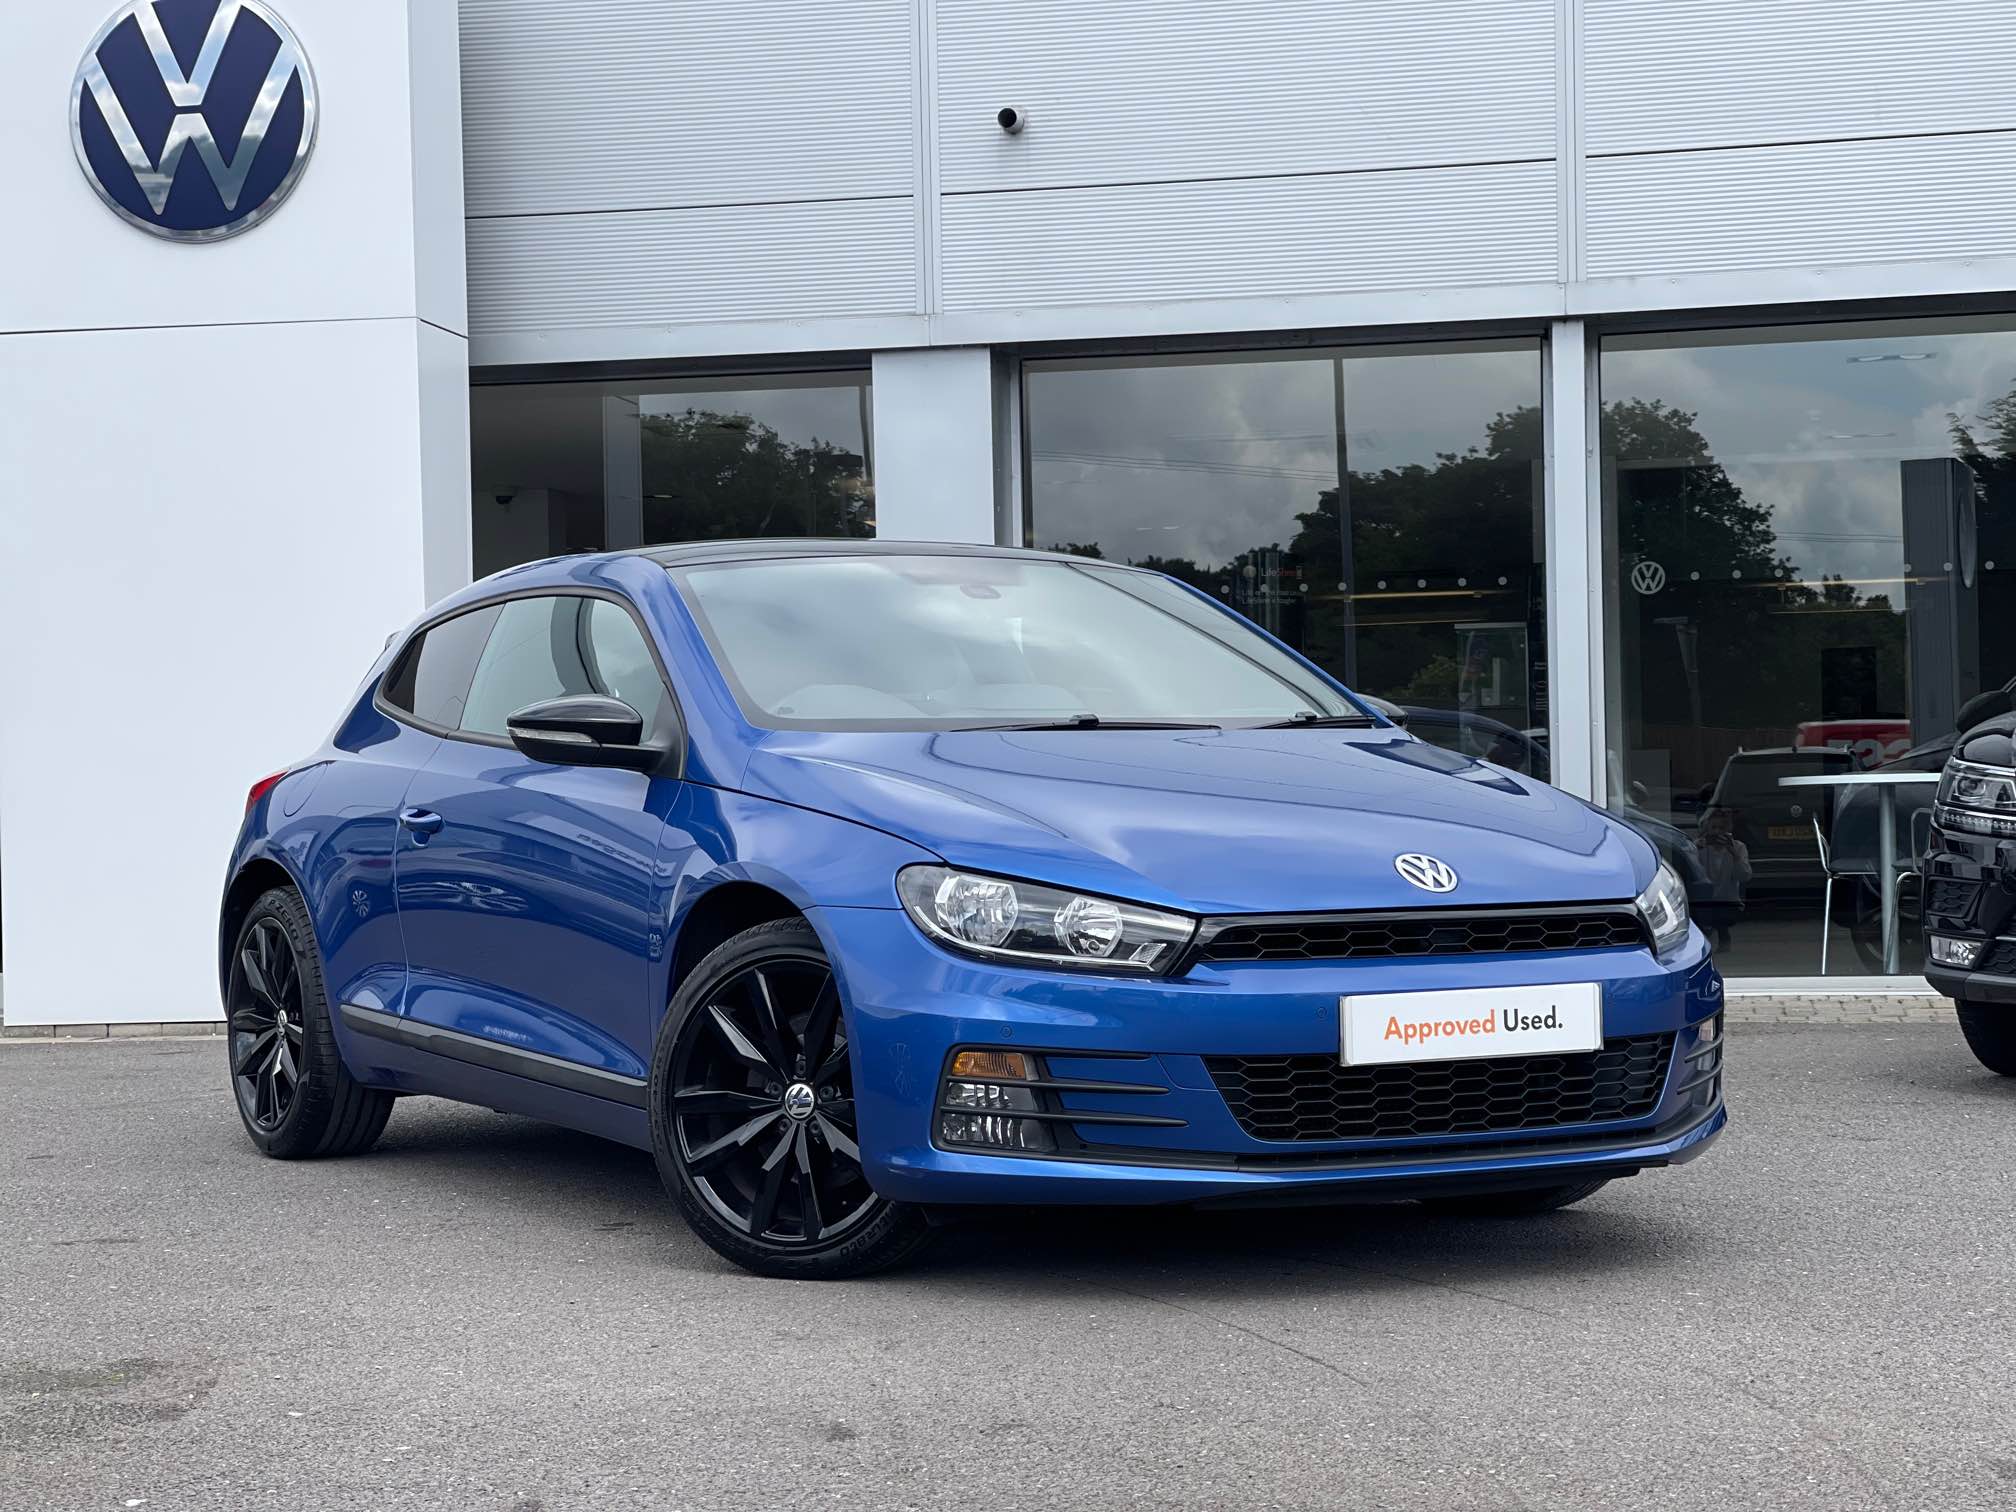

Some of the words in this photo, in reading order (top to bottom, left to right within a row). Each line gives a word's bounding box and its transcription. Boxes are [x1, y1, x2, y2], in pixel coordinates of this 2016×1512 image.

[78, 0, 308, 228] VW
[1633, 562, 1664, 593] VW
[1396, 854, 1457, 891] VW
[1384, 1009, 1496, 1044] Approved
[1503, 1005, 1563, 1031] Used.
